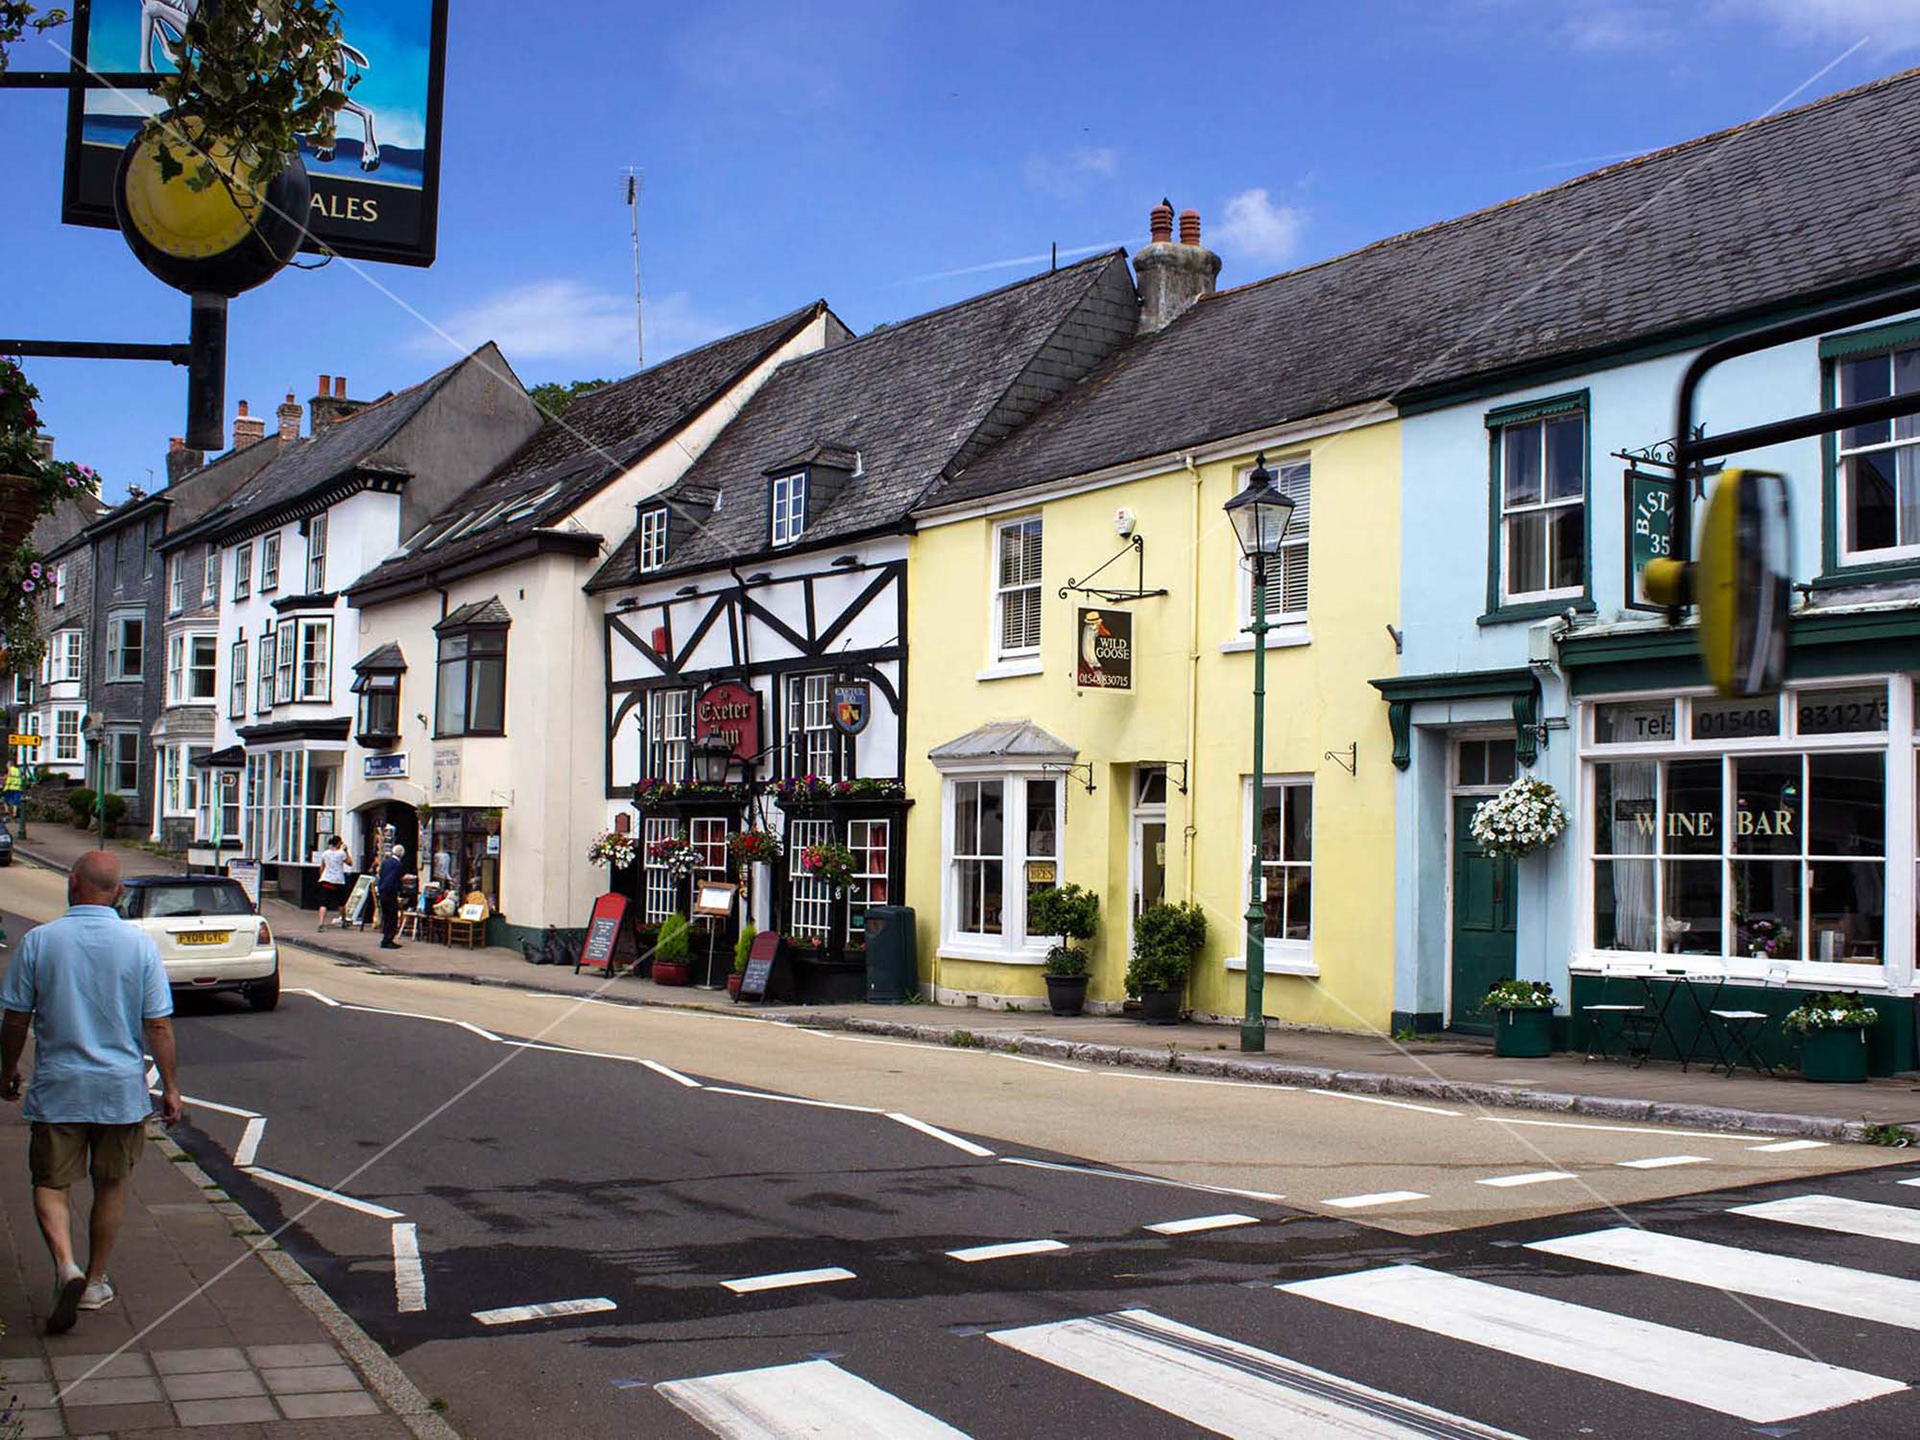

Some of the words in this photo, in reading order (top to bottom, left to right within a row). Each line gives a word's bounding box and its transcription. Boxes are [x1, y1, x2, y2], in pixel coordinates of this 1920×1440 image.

[1635, 491, 1675, 537] BIST
[1650, 533, 1671, 555] 35
[1096, 647, 1130, 660] GOOSE
[1099, 637, 1127, 649] WILD
[699, 701, 750, 722] Exeter
[1634, 714, 1672, 736] Tel:
[1699, 709, 1772, 733] 01548
[1633, 812, 1714, 836] WINE
[1736, 810, 1794, 836] BAR
